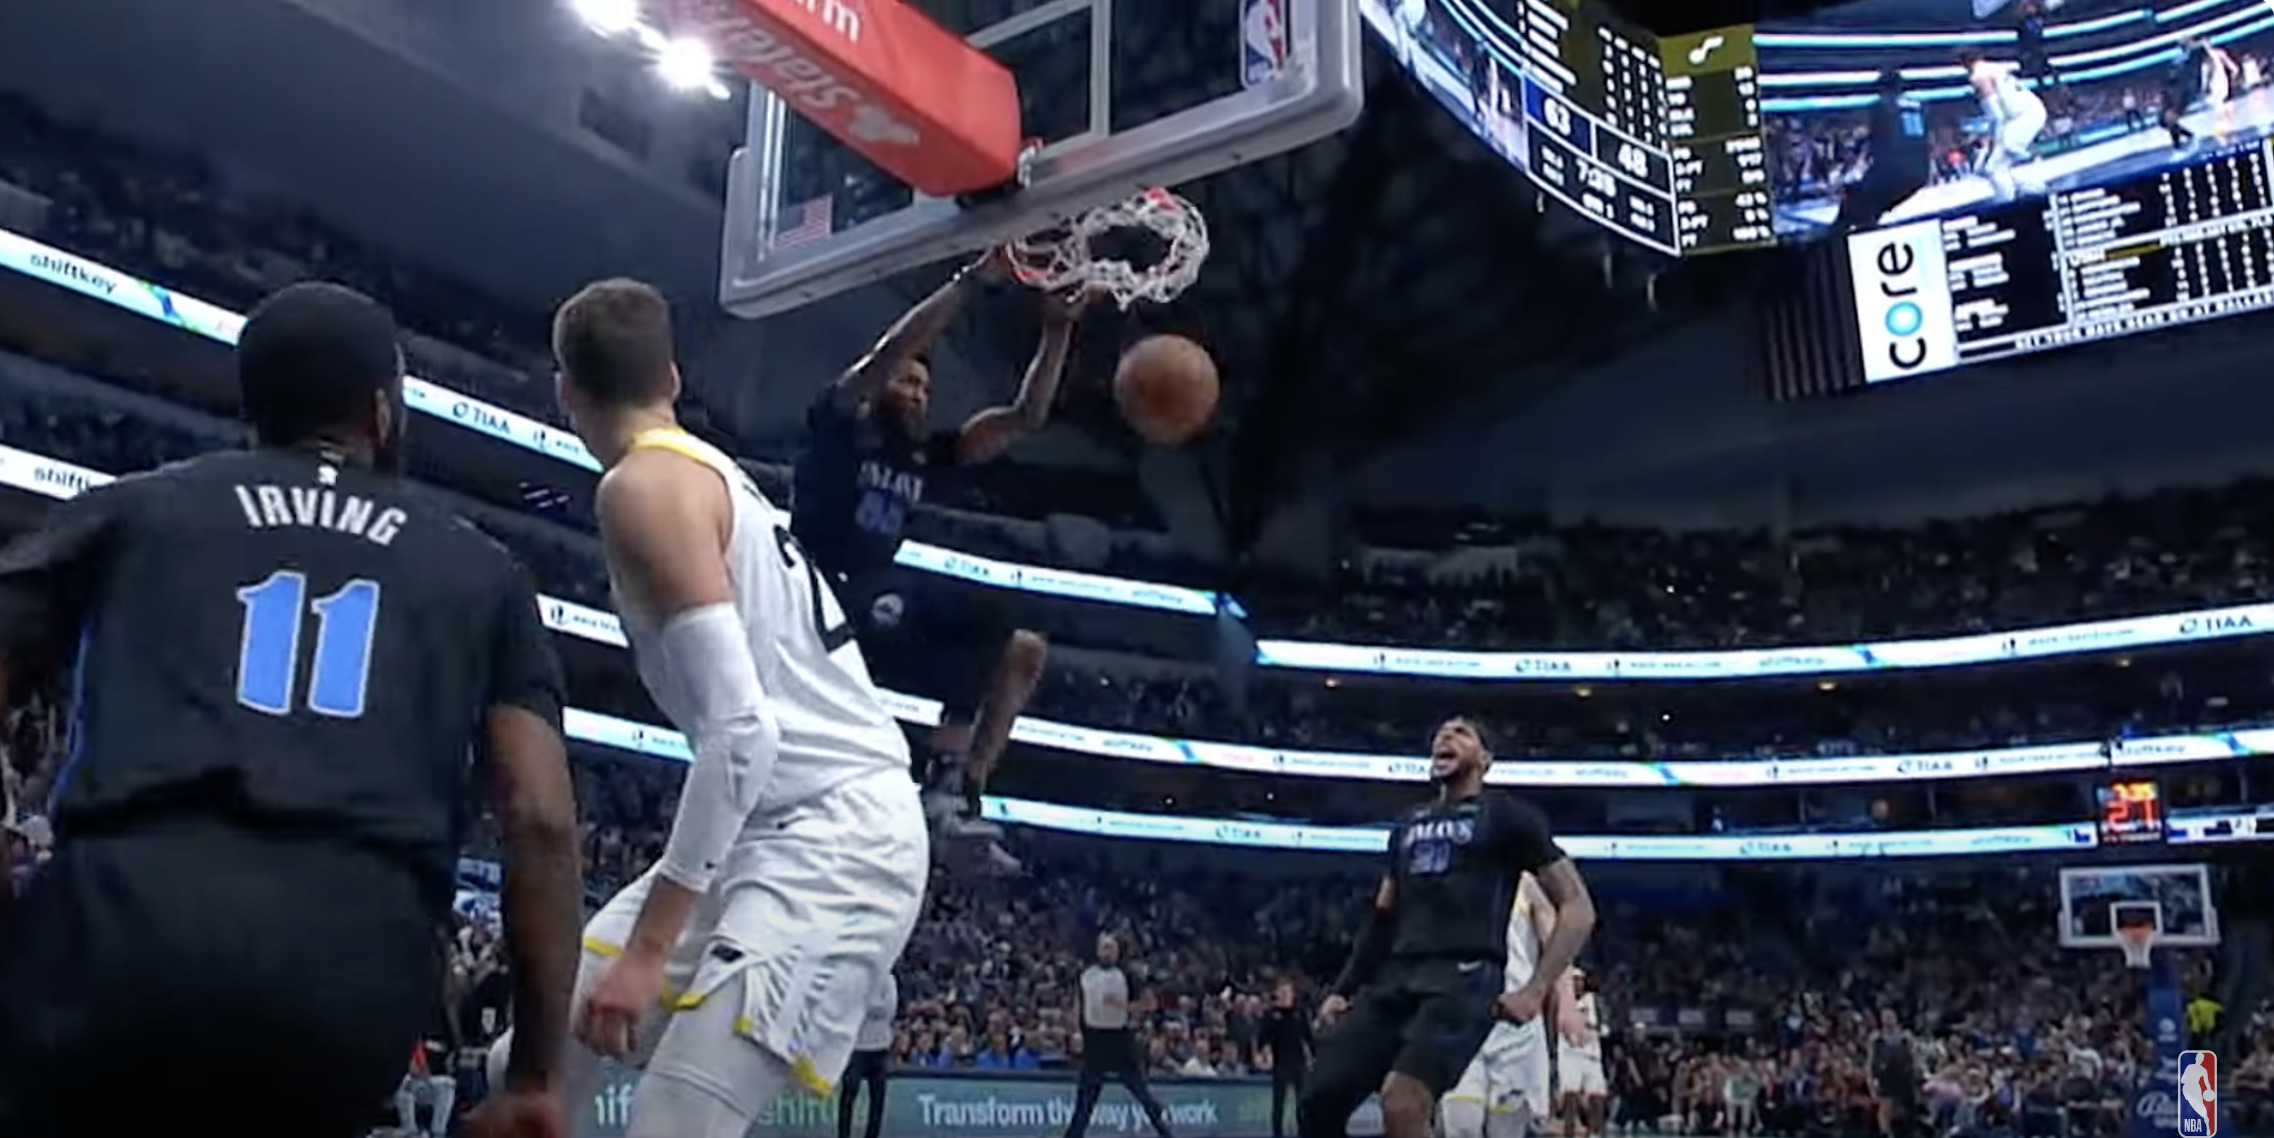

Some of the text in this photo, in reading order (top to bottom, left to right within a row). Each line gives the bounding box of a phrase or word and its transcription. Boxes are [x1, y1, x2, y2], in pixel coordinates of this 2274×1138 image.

[1544, 97, 1571, 136] 63
[1618, 143, 1648, 178] 48
[29, 252, 118, 296] shiftkey
[1877, 241, 1927, 370] core
[473, 407, 511, 435] TIAA
[235, 484, 406, 546] IRVING
[2205, 614, 2253, 634] TIAA
[236, 569, 380, 719] 11
[918, 1094, 1044, 1126] Transform
